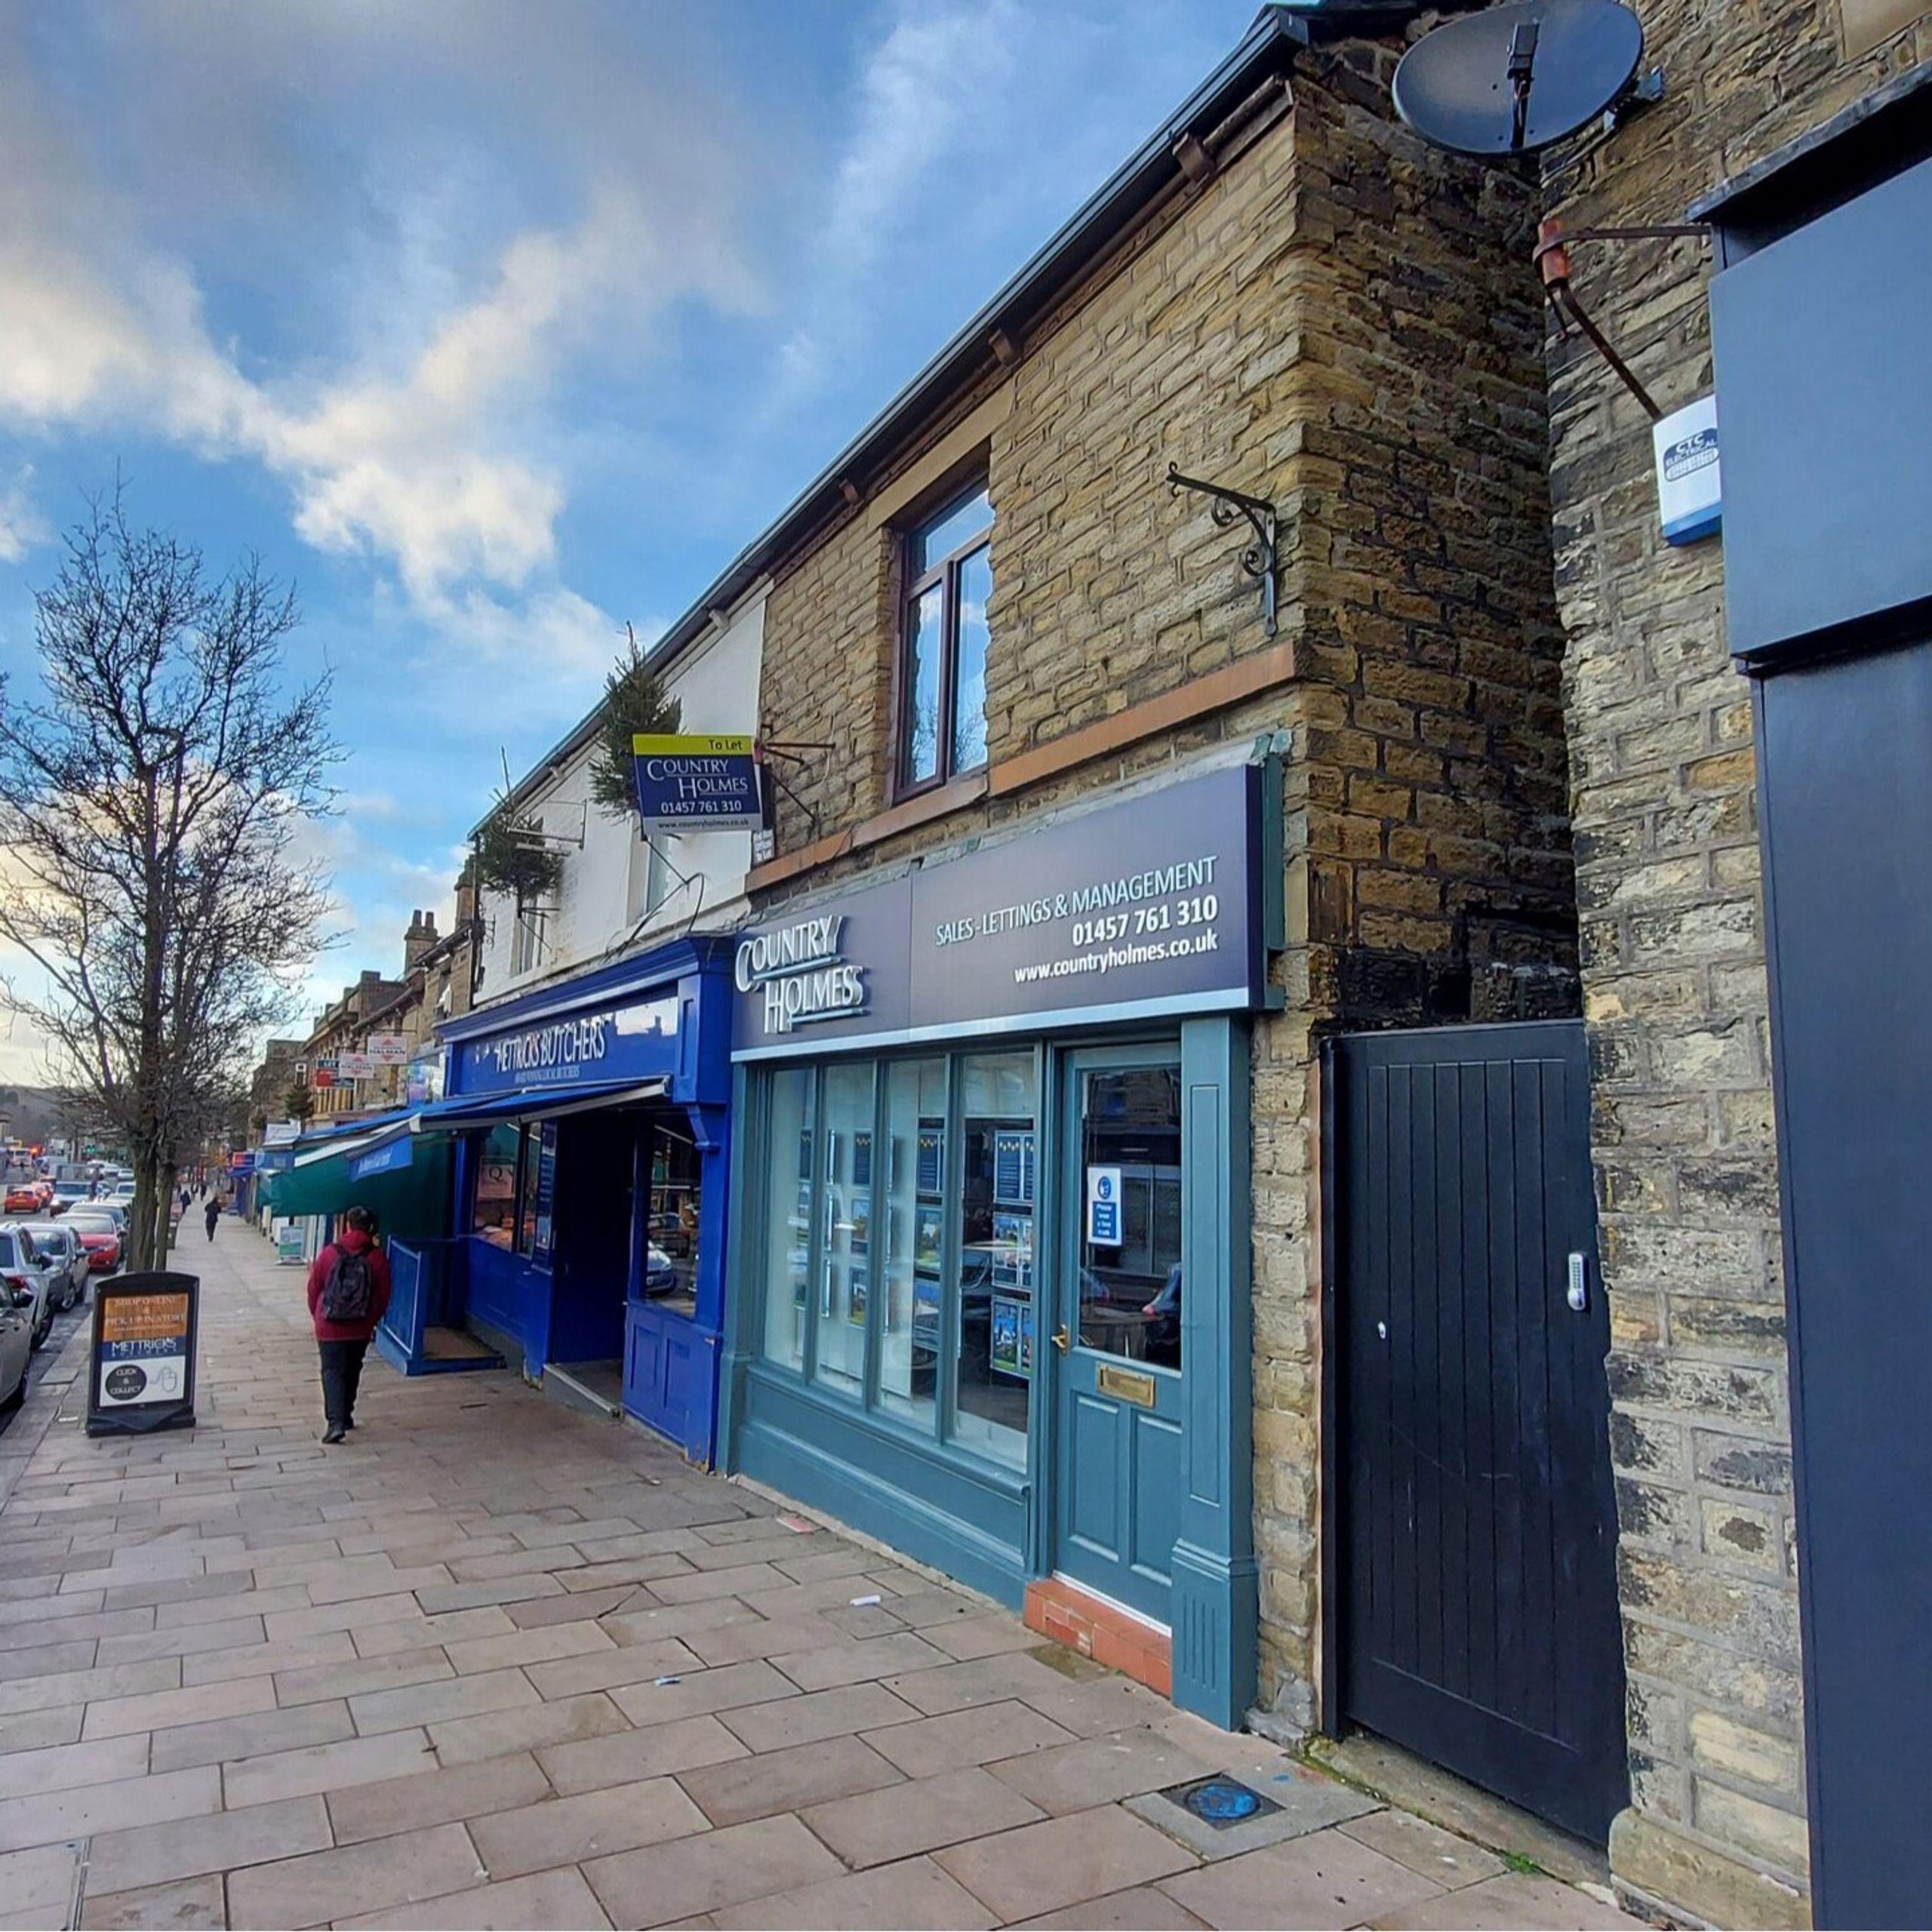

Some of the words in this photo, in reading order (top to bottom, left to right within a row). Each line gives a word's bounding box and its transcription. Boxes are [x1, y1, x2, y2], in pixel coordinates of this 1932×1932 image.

[647, 758, 729, 781] COUNTRY
[708, 740, 722, 751] To
[725, 740, 743, 751] Let
[660, 801, 696, 814] 01457
[698, 801, 719, 813] 761
[721, 800, 742, 811] 310
[678, 777, 749, 798] HOLMES
[983, 898, 1051, 935] LETTINGS
[1054, 894, 1069, 918] &
[1072, 855, 1218, 915] MANAGEMENT
[1072, 913, 1130, 946] 01457
[1134, 904, 1172, 935] 761
[1176, 894, 1219, 926] 310
[735, 915, 843, 992] COUNTRY
[1014, 928, 1219, 983] www.countryholmes.co.uk
[764, 965, 863, 1034] HOLMES
[540, 1015, 606, 1066] BUTCHERS
